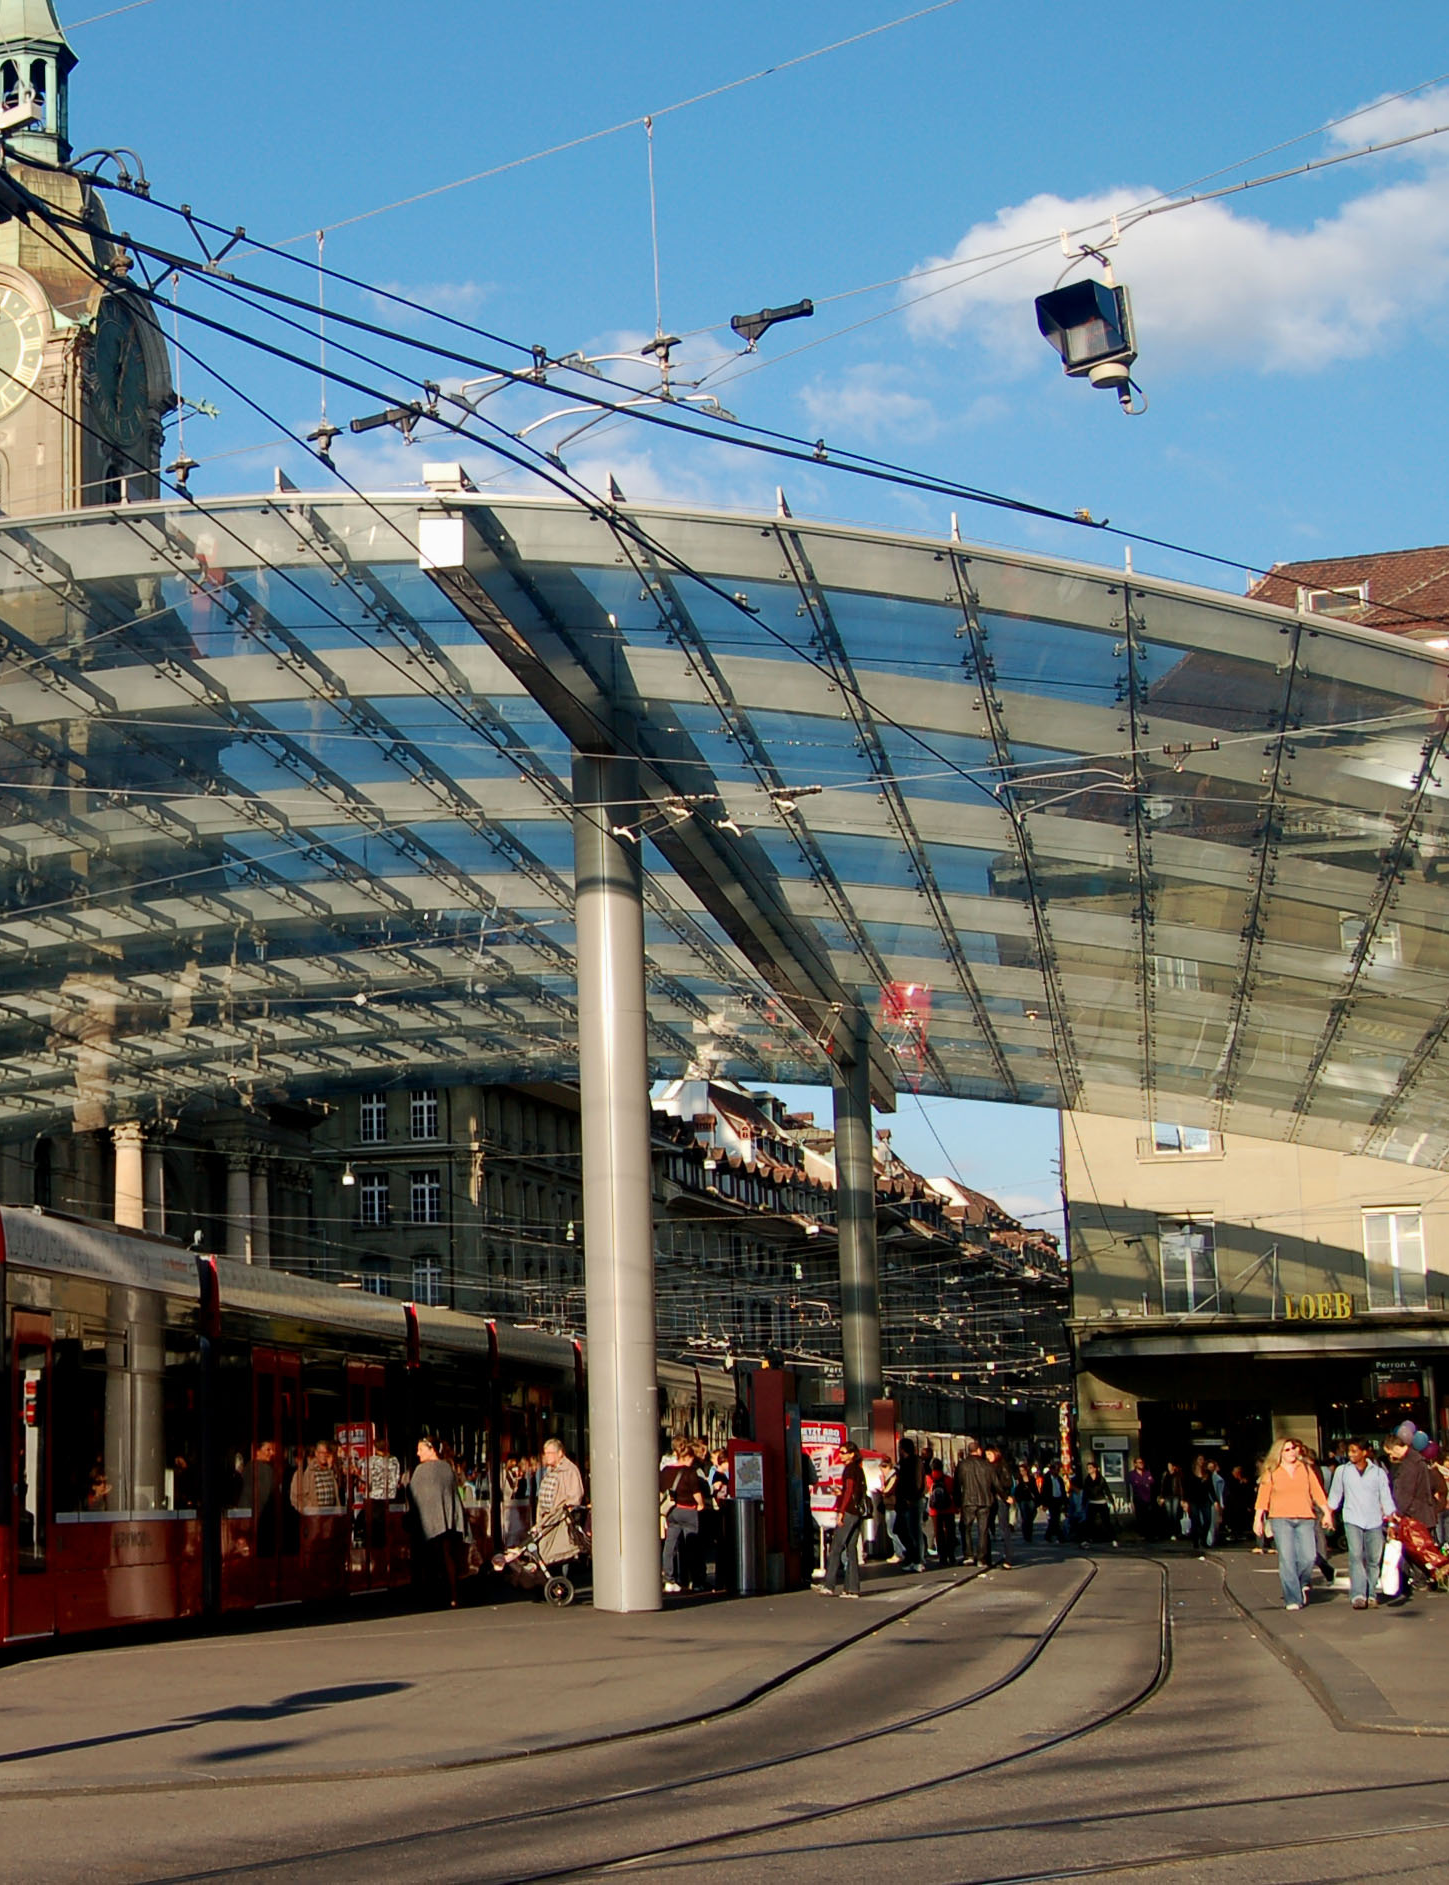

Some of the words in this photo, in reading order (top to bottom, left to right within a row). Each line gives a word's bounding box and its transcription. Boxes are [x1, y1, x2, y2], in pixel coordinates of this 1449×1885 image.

[1284, 1292, 1351, 1320] LOEB
[1375, 1361, 1406, 1369] Perron
[1409, 1360, 1416, 1368] A
